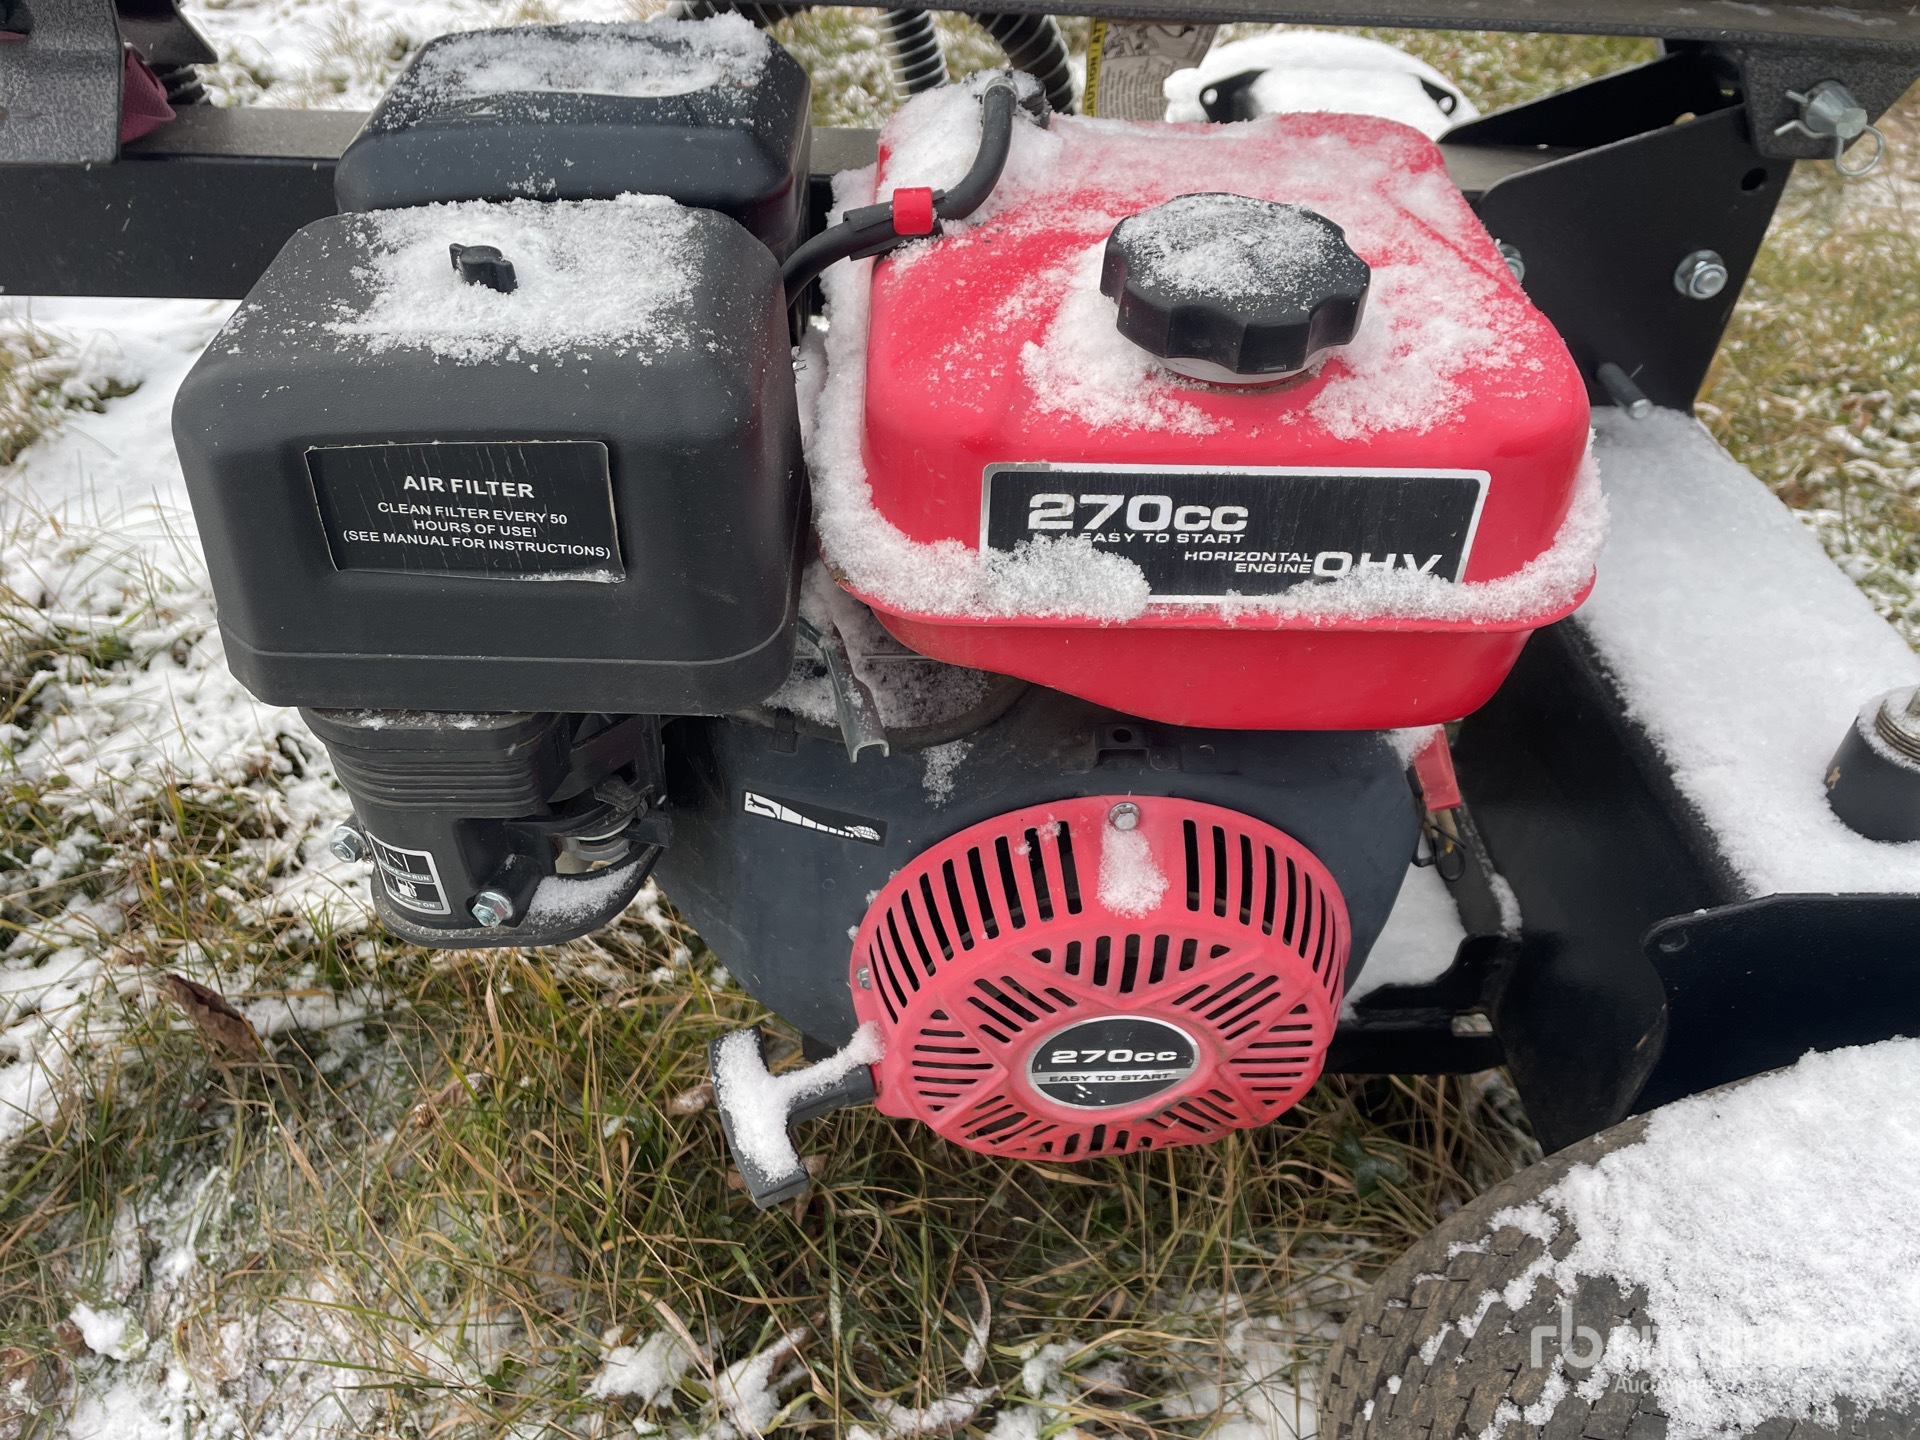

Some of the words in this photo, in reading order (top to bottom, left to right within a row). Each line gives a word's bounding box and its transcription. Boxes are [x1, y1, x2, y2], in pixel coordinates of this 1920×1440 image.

[403, 475, 446, 493] AIR
[450, 478, 535, 498] FILTER
[377, 502, 431, 516] CLEAN
[434, 505, 490, 519] FILTER
[493, 509, 547, 523] EVERY
[550, 513, 568, 525] 50
[1027, 492, 1249, 531] 270cc
[413, 519, 472, 533] HOURS
[474, 523, 496, 535] OF
[500, 525, 537, 538] USE!
[343, 529, 381, 543] (SEE
[382, 532, 450, 547] MANUAL
[452, 536, 486, 549] FOR
[488, 539, 611, 560] INSTRUCTIONS)
[1080, 532, 1136, 543] EASY
[1142, 532, 1169, 543] TO
[1176, 533, 1246, 544] START
[1183, 550, 1314, 562] HORIZONTAL
[1313, 551, 1443, 577] OHV
[1234, 562, 1312, 574] ENGINE
[411, 874, 430, 882] RUN
[1050, 1049, 1178, 1064] 270cc
[1049, 1074, 1092, 1083] EASY
[1095, 1074, 1116, 1082] TO
[1120, 1072, 1172, 1082] START
